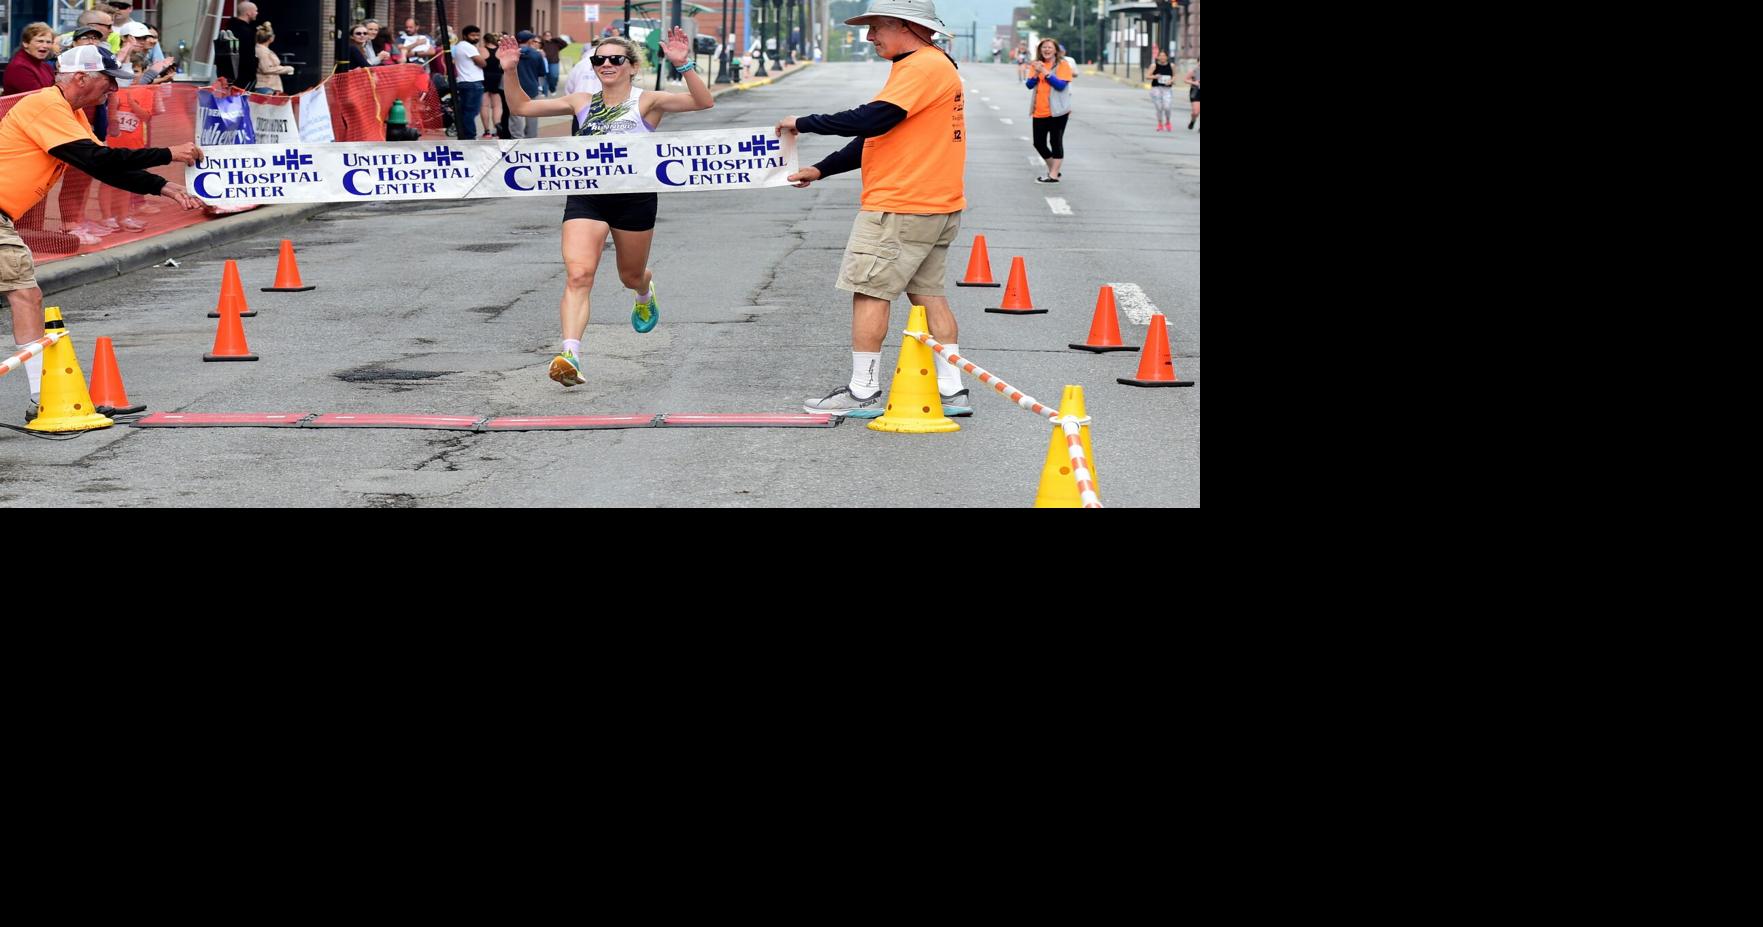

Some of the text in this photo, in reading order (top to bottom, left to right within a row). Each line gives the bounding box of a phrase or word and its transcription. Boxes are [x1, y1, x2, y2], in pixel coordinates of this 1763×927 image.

[120, 117, 138, 127] 142
[501, 151, 580, 164] UNITED
[656, 143, 732, 158] UNITED
[195, 156, 266, 170] UNITED
[343, 153, 417, 167] UNITED
[691, 157, 787, 172] HOSPITAL
[228, 171, 323, 185] HOSPITAL
[377, 167, 474, 181] HOSPITAL
[504, 165, 598, 191] CENTER
[540, 164, 637, 178] HOSPITAL
[655, 159, 751, 186] CENTER
[194, 172, 284, 198] CENTER
[342, 168, 436, 196] CENTER
